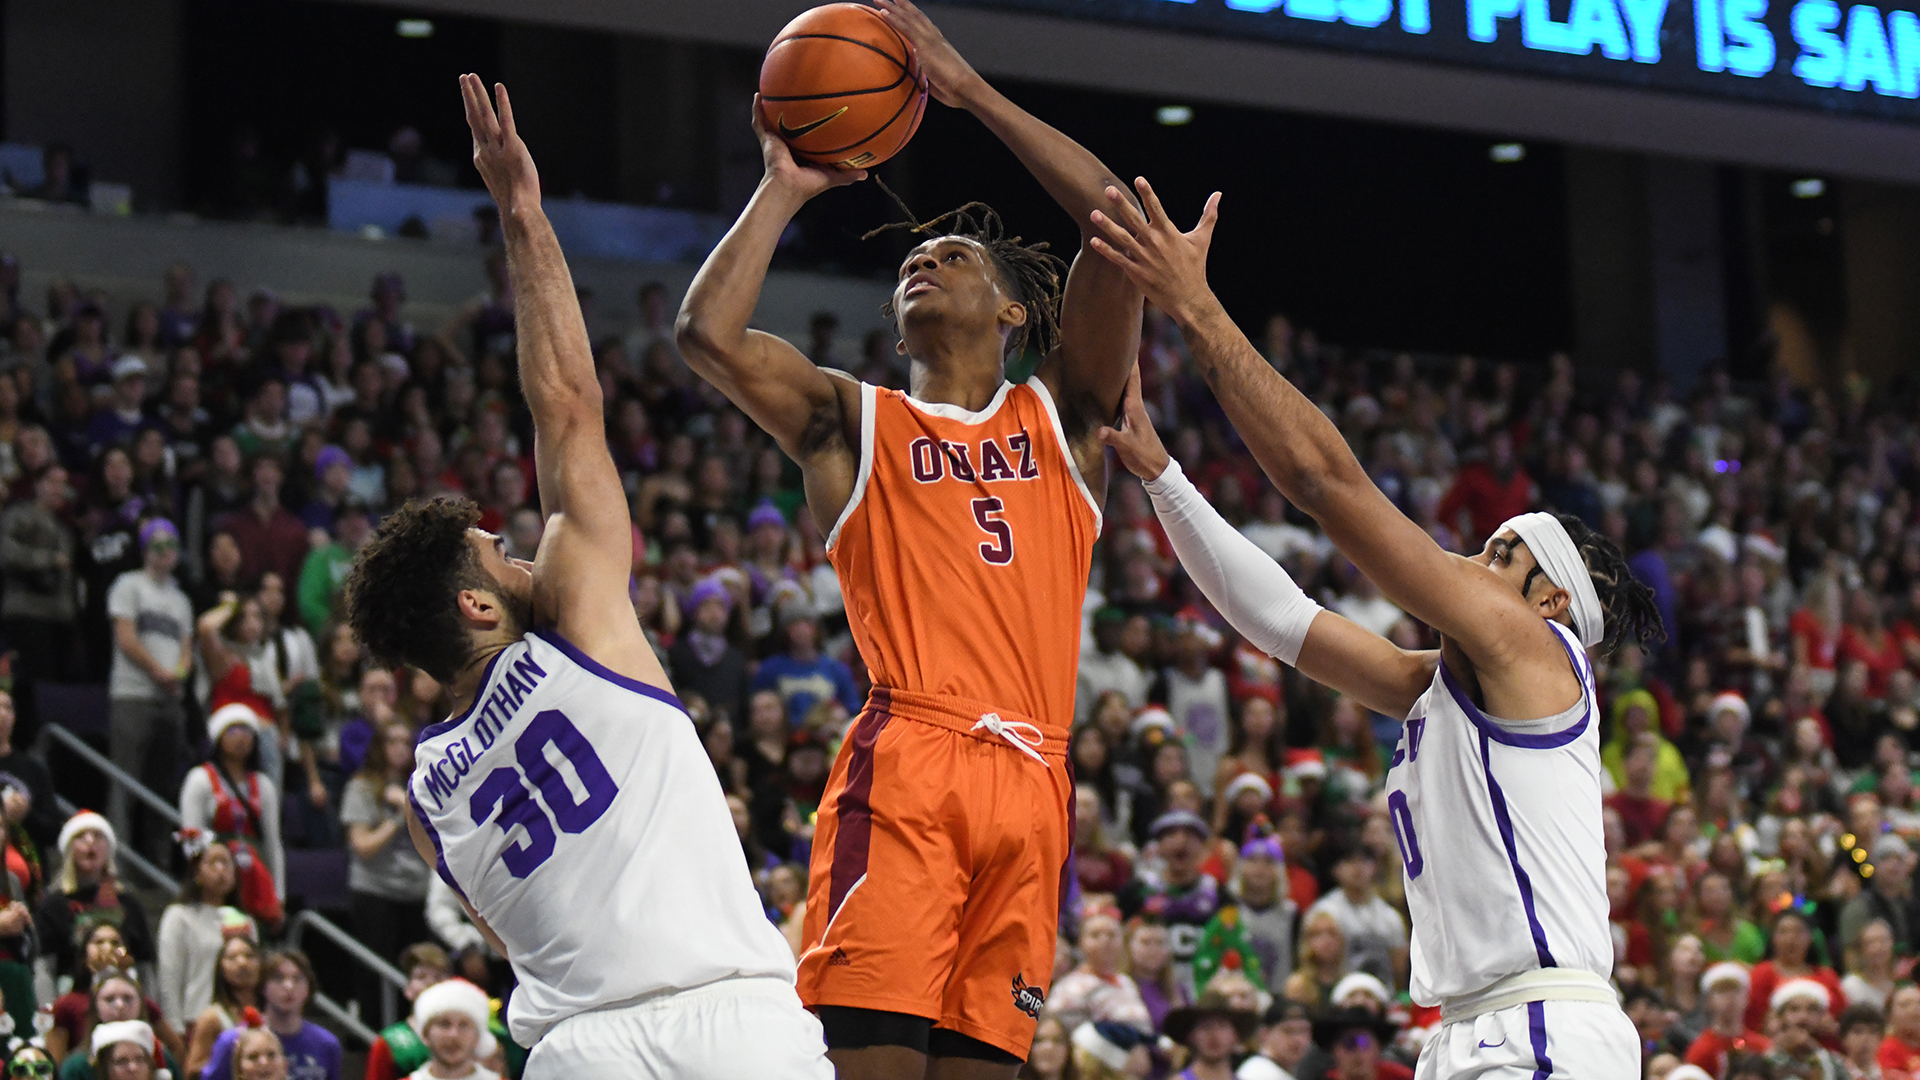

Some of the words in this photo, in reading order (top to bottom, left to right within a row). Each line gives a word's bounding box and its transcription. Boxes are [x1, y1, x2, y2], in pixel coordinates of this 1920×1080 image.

[1466, 0, 1661, 64] PLAY
[1693, 0, 1776, 78] IS
[909, 427, 1041, 484] OUAZ
[970, 495, 1014, 566] 5
[424, 651, 547, 810] MCGLOTHAN
[470, 709, 620, 879] 30
